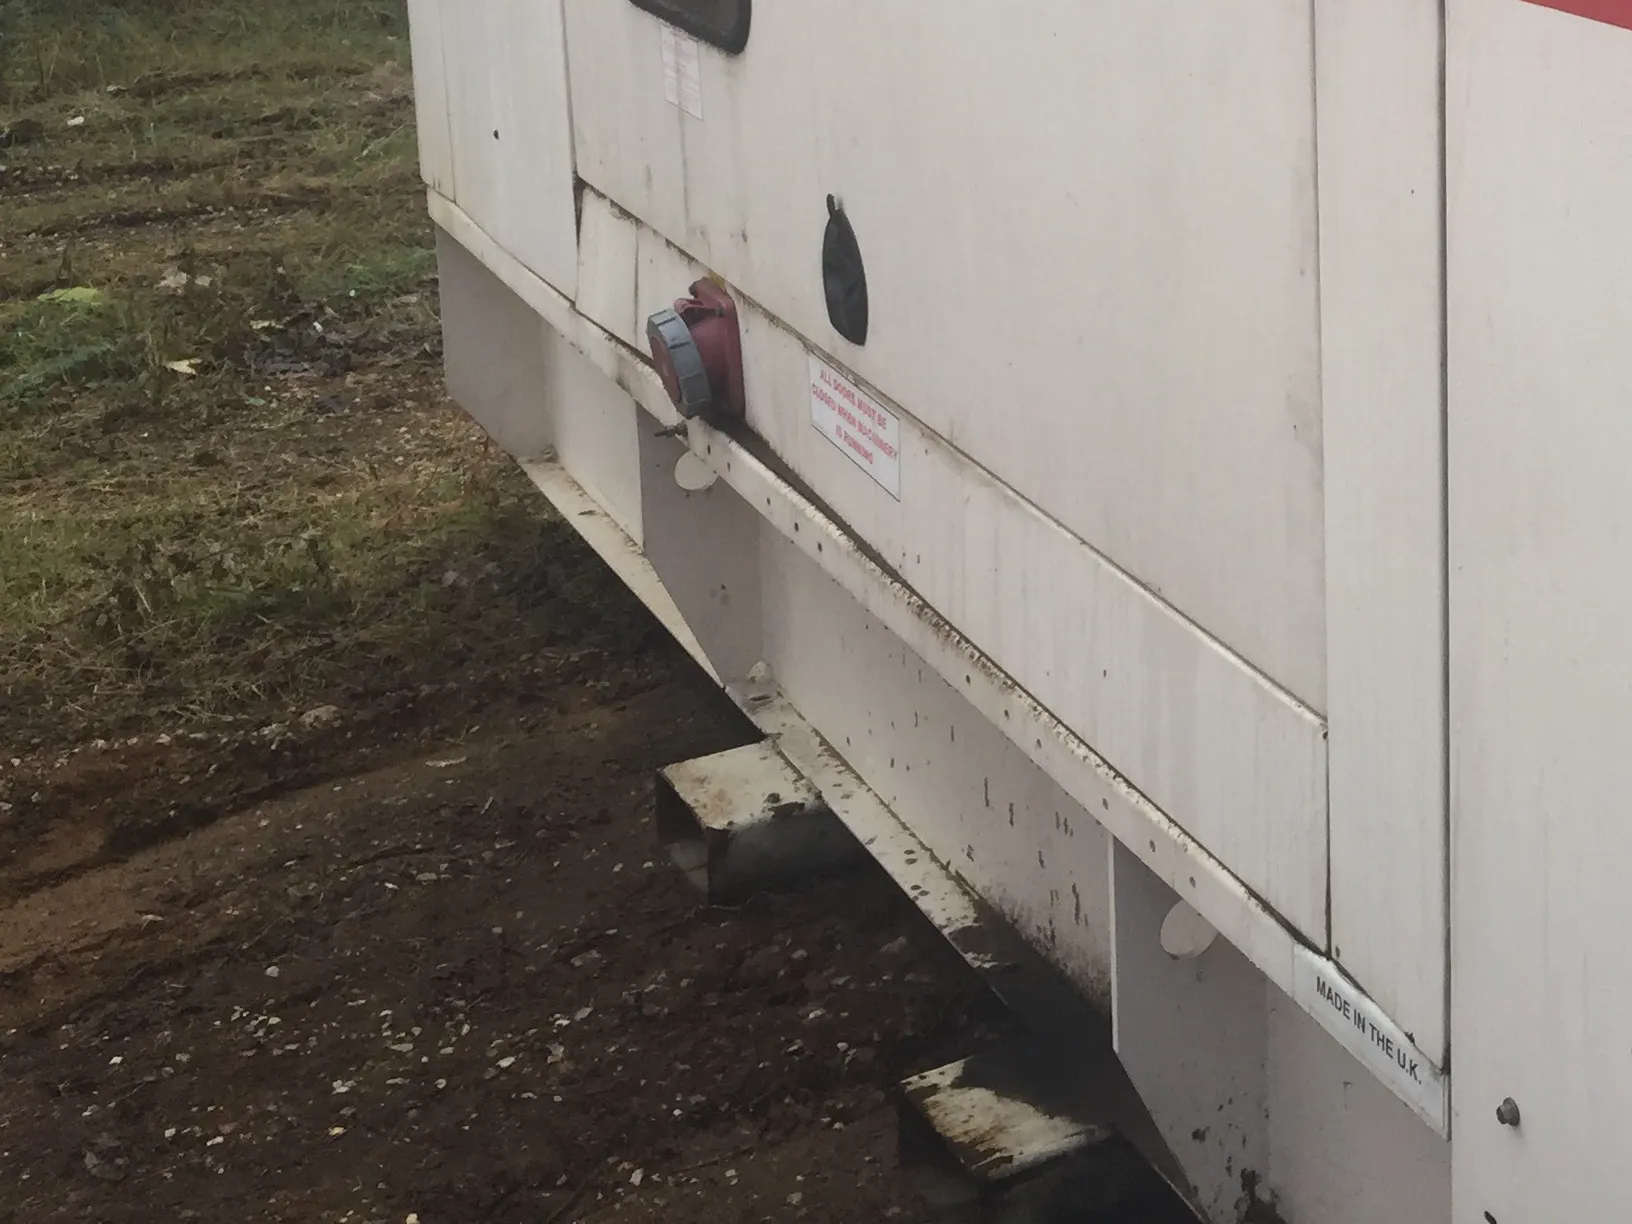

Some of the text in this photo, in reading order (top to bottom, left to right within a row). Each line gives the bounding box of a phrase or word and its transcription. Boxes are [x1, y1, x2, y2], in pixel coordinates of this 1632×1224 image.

[1316, 976, 1422, 1085] MADE IN THE U.K.
